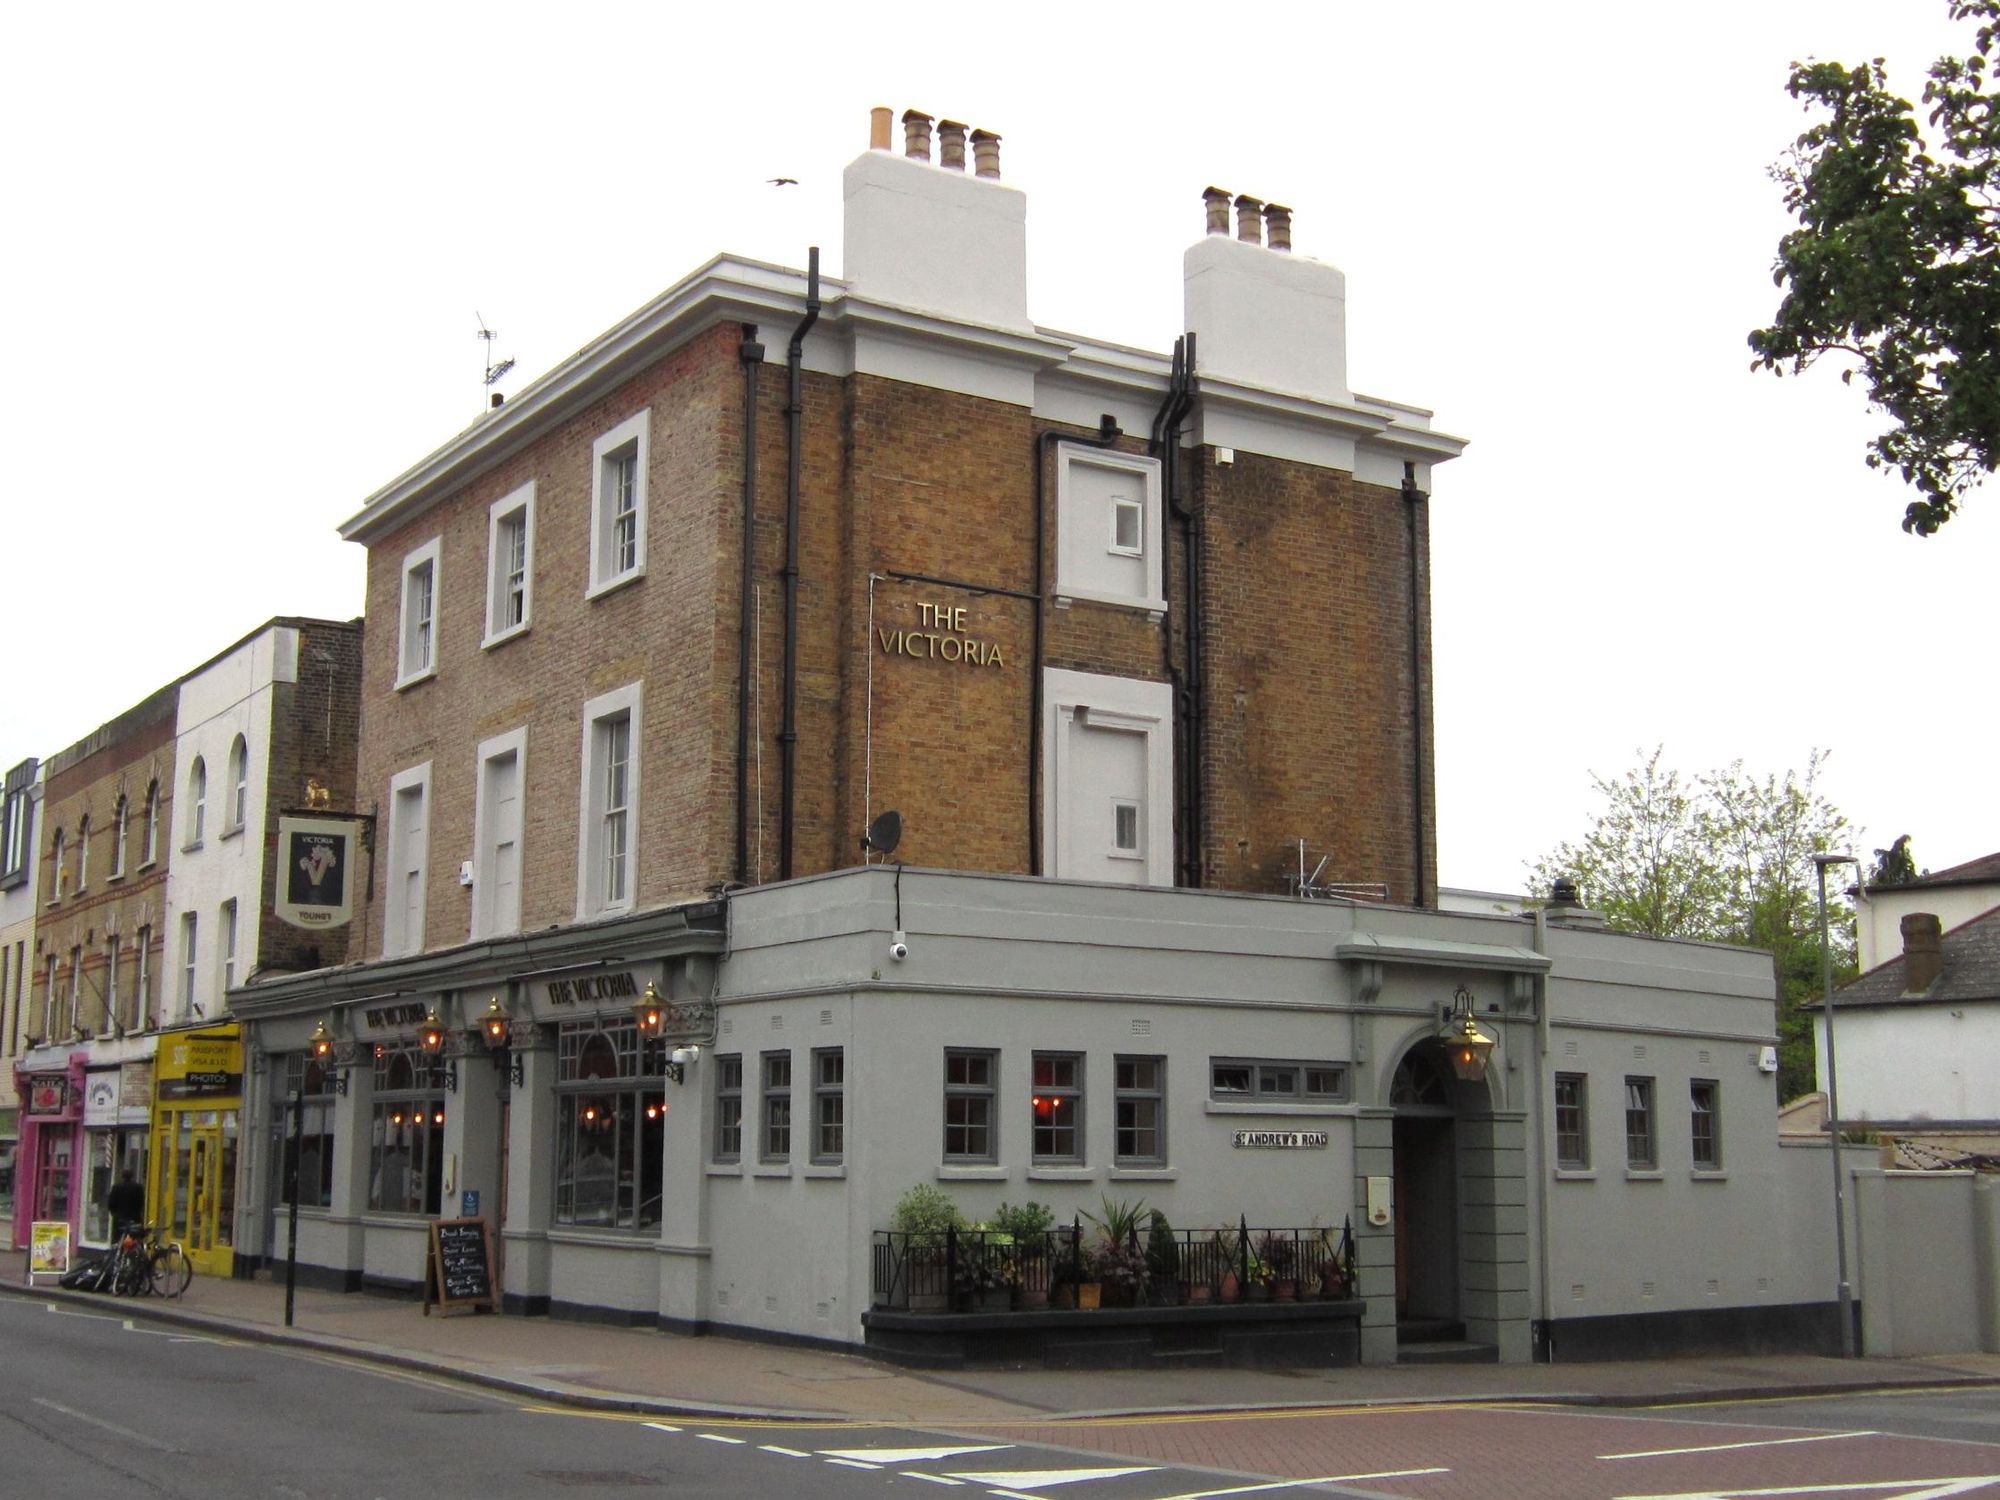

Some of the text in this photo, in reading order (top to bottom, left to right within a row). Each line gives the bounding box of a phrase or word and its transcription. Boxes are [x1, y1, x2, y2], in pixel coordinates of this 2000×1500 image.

[917, 602, 968, 632] THE
[878, 628, 1004, 668] VICTORIA
[301, 836, 334, 844] VICTORIA
[547, 972, 638, 1006] THE VICTORIA
[191, 1046, 229, 1054] PASSPORT
[190, 1074, 227, 1082] PHOTOS
[31, 1080, 65, 1088] NAILS
[1248, 1132, 1298, 1145] ANDREW'S
[1302, 1134, 1329, 1146] ROAD
